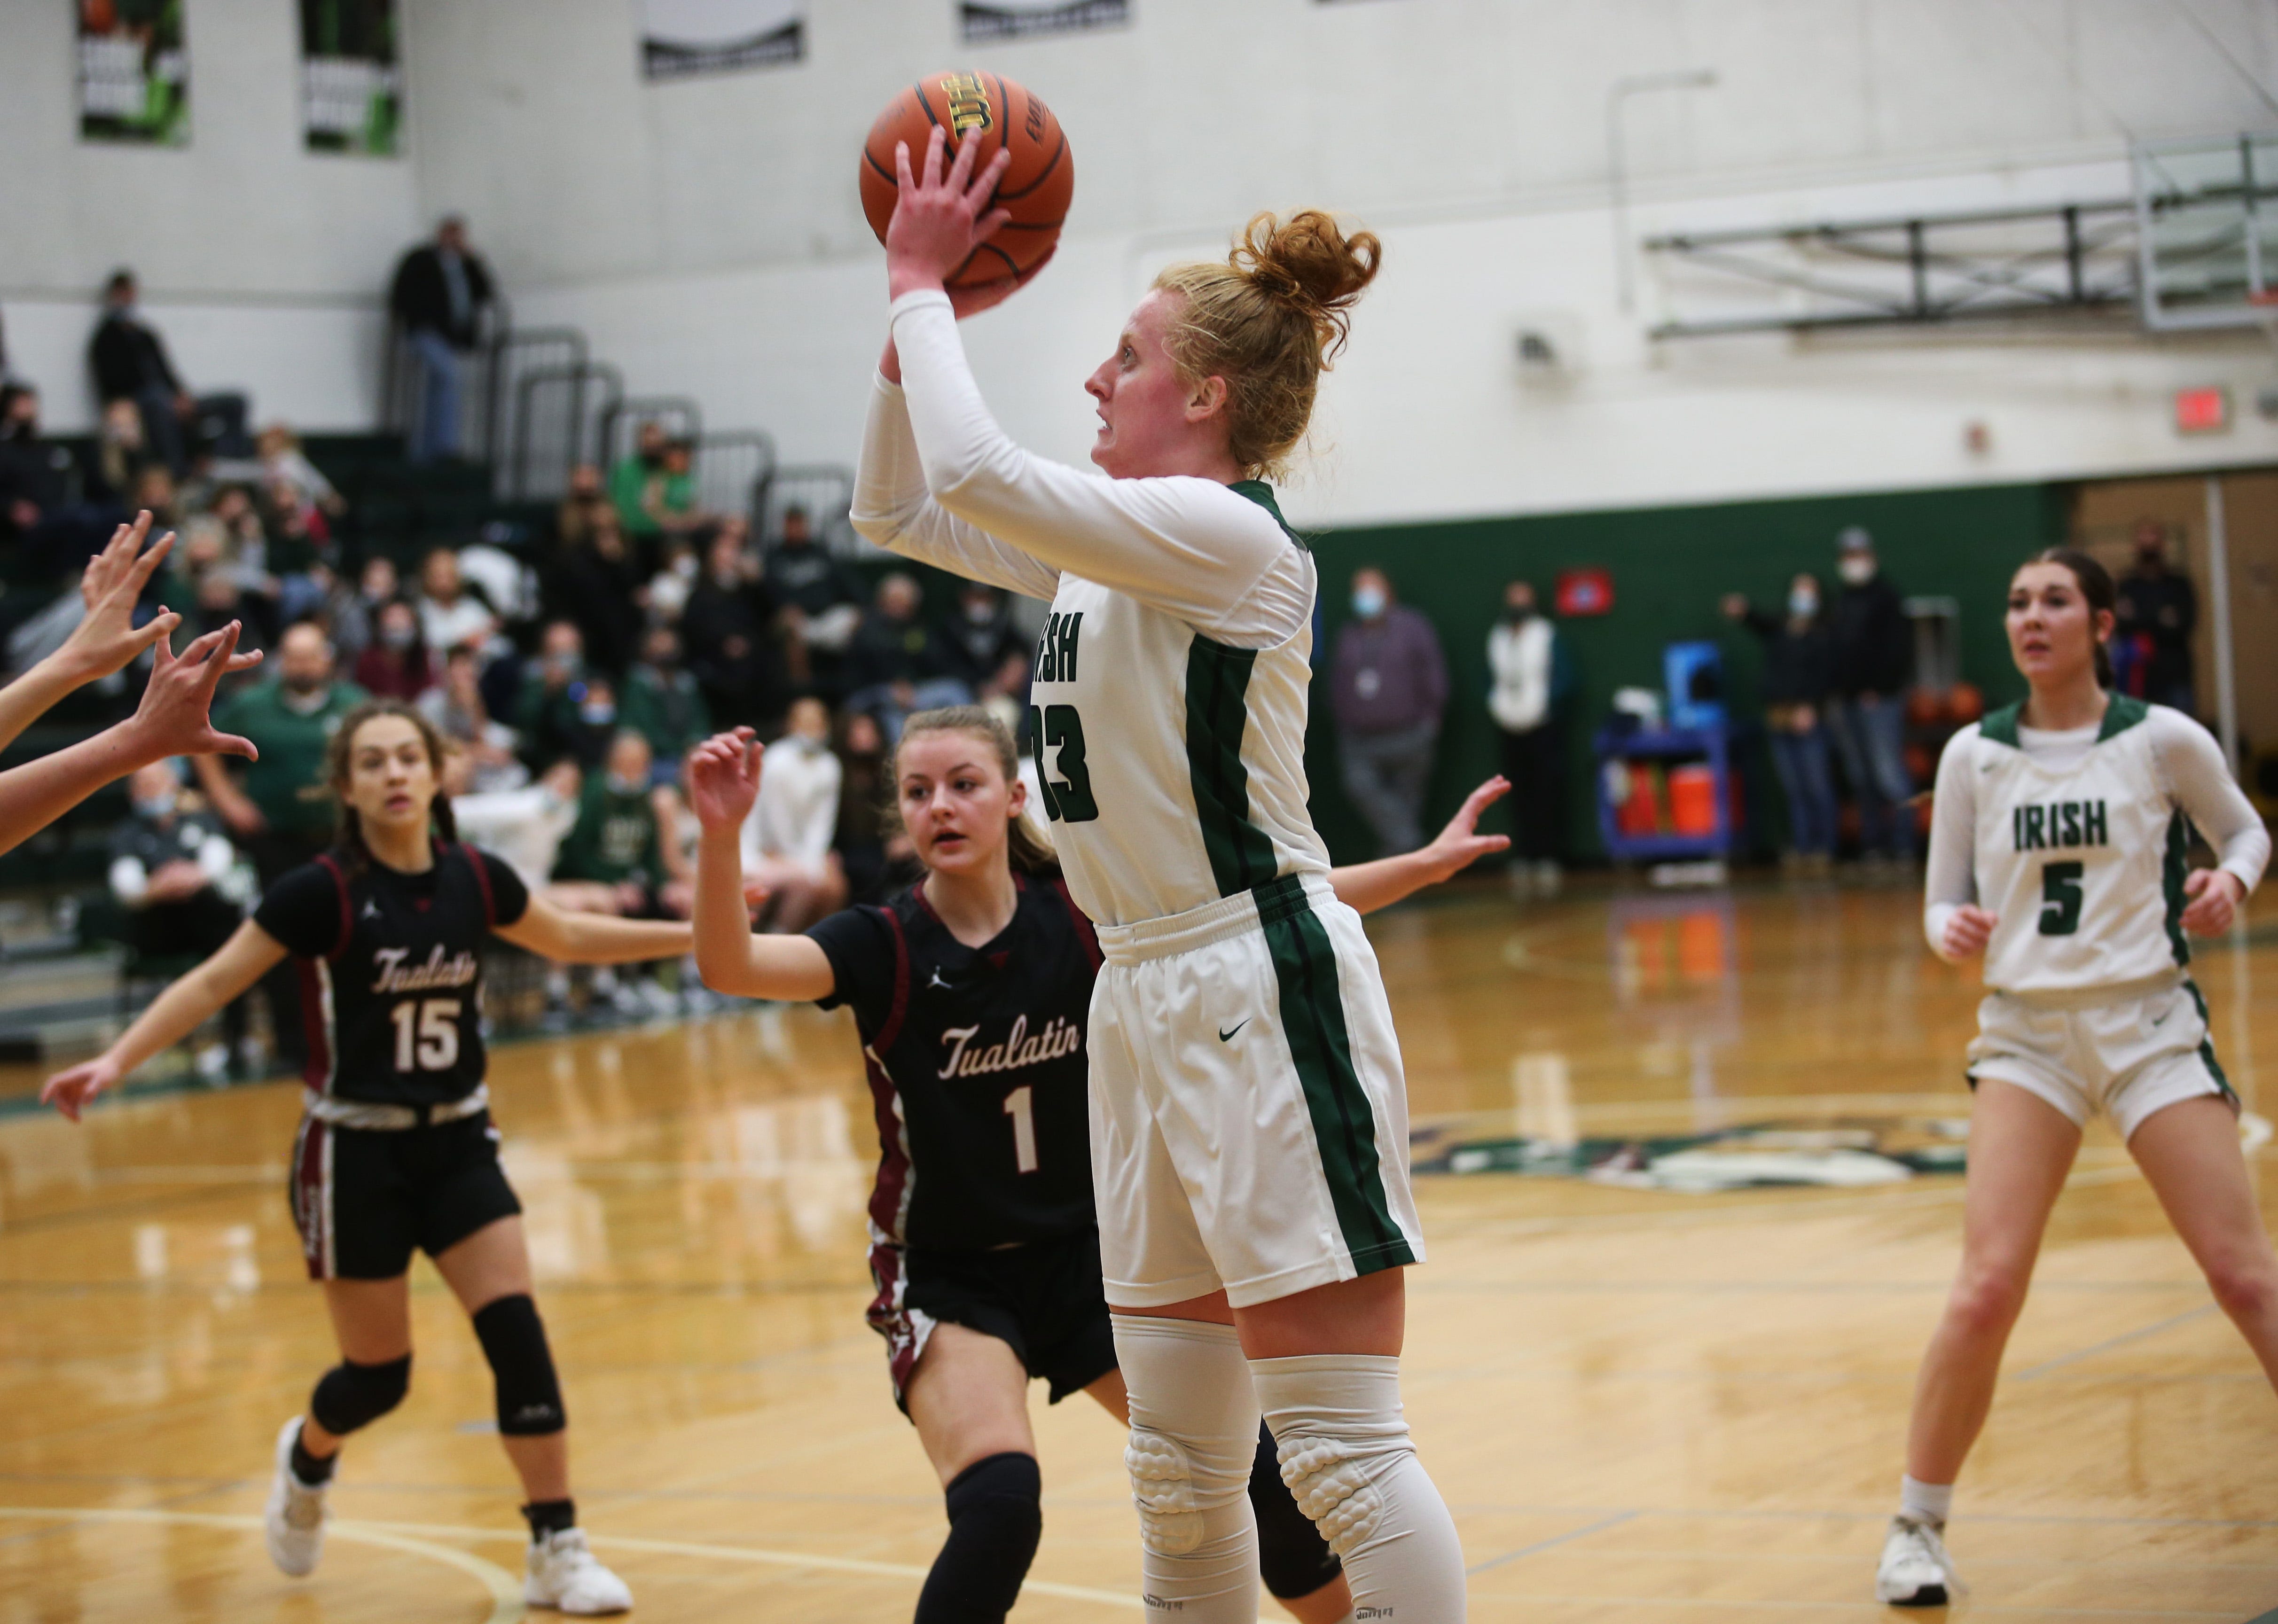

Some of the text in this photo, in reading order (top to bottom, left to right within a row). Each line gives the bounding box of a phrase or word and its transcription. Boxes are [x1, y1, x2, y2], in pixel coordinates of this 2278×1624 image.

[2013, 800, 2107, 851] IRISH
[2038, 860, 2083, 936] 5
[390, 997, 462, 1072] 15
[938, 1014, 1080, 1079] Tualatin
[1004, 1085, 1038, 1173] 1
